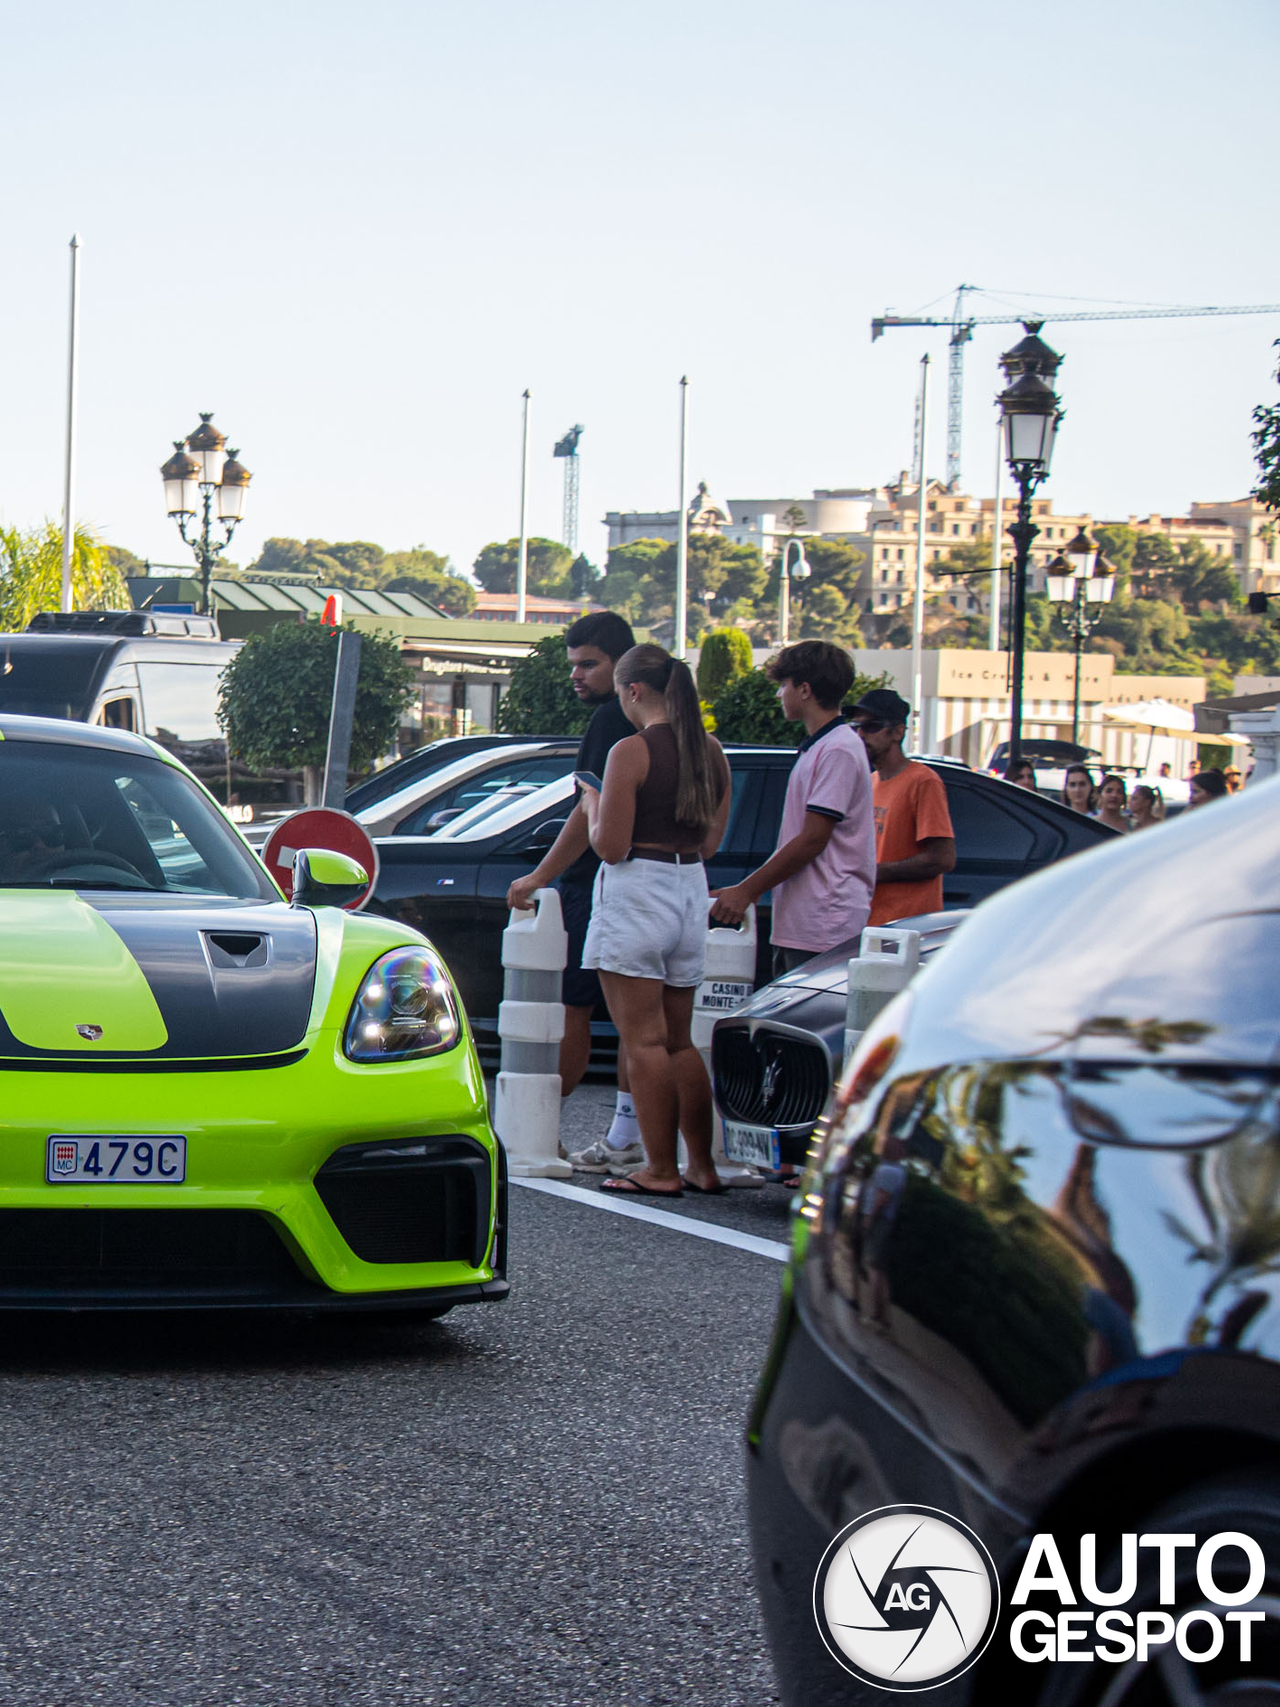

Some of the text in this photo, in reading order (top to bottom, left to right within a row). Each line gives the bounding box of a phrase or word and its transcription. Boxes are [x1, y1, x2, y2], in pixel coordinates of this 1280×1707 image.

[951, 668, 973, 679] Ice
[982, 669, 1035, 681] Cres
[1065, 674, 1099, 684] Mre
[712, 983, 745, 996] CASINO
[57, 1141, 178, 1176] MC 479C
